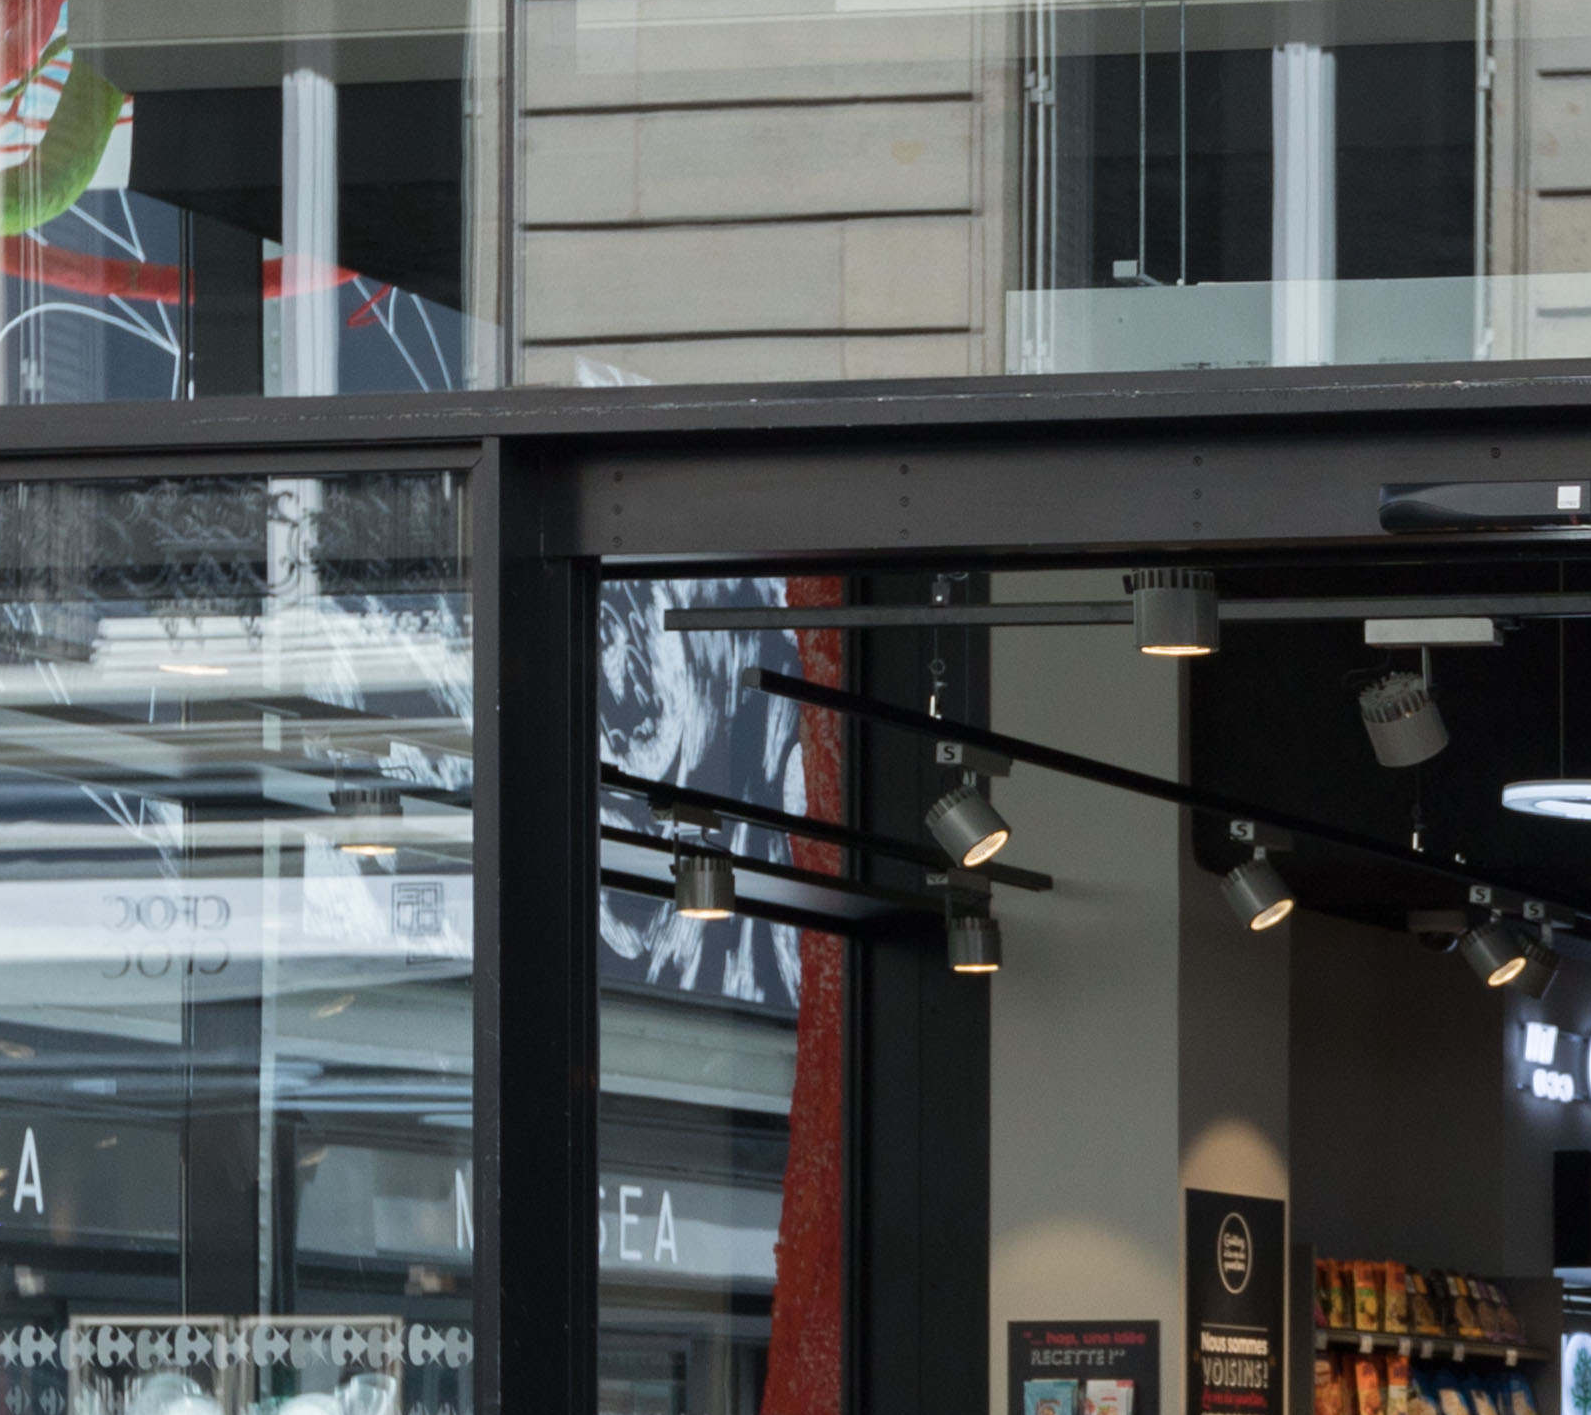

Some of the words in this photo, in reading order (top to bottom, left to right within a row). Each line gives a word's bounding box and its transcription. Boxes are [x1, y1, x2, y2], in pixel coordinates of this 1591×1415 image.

[1201, 1331, 1227, 1353] Nous
[1227, 1337, 1268, 1356] sommes
[1031, 1349, 1105, 1366] RECETTE
